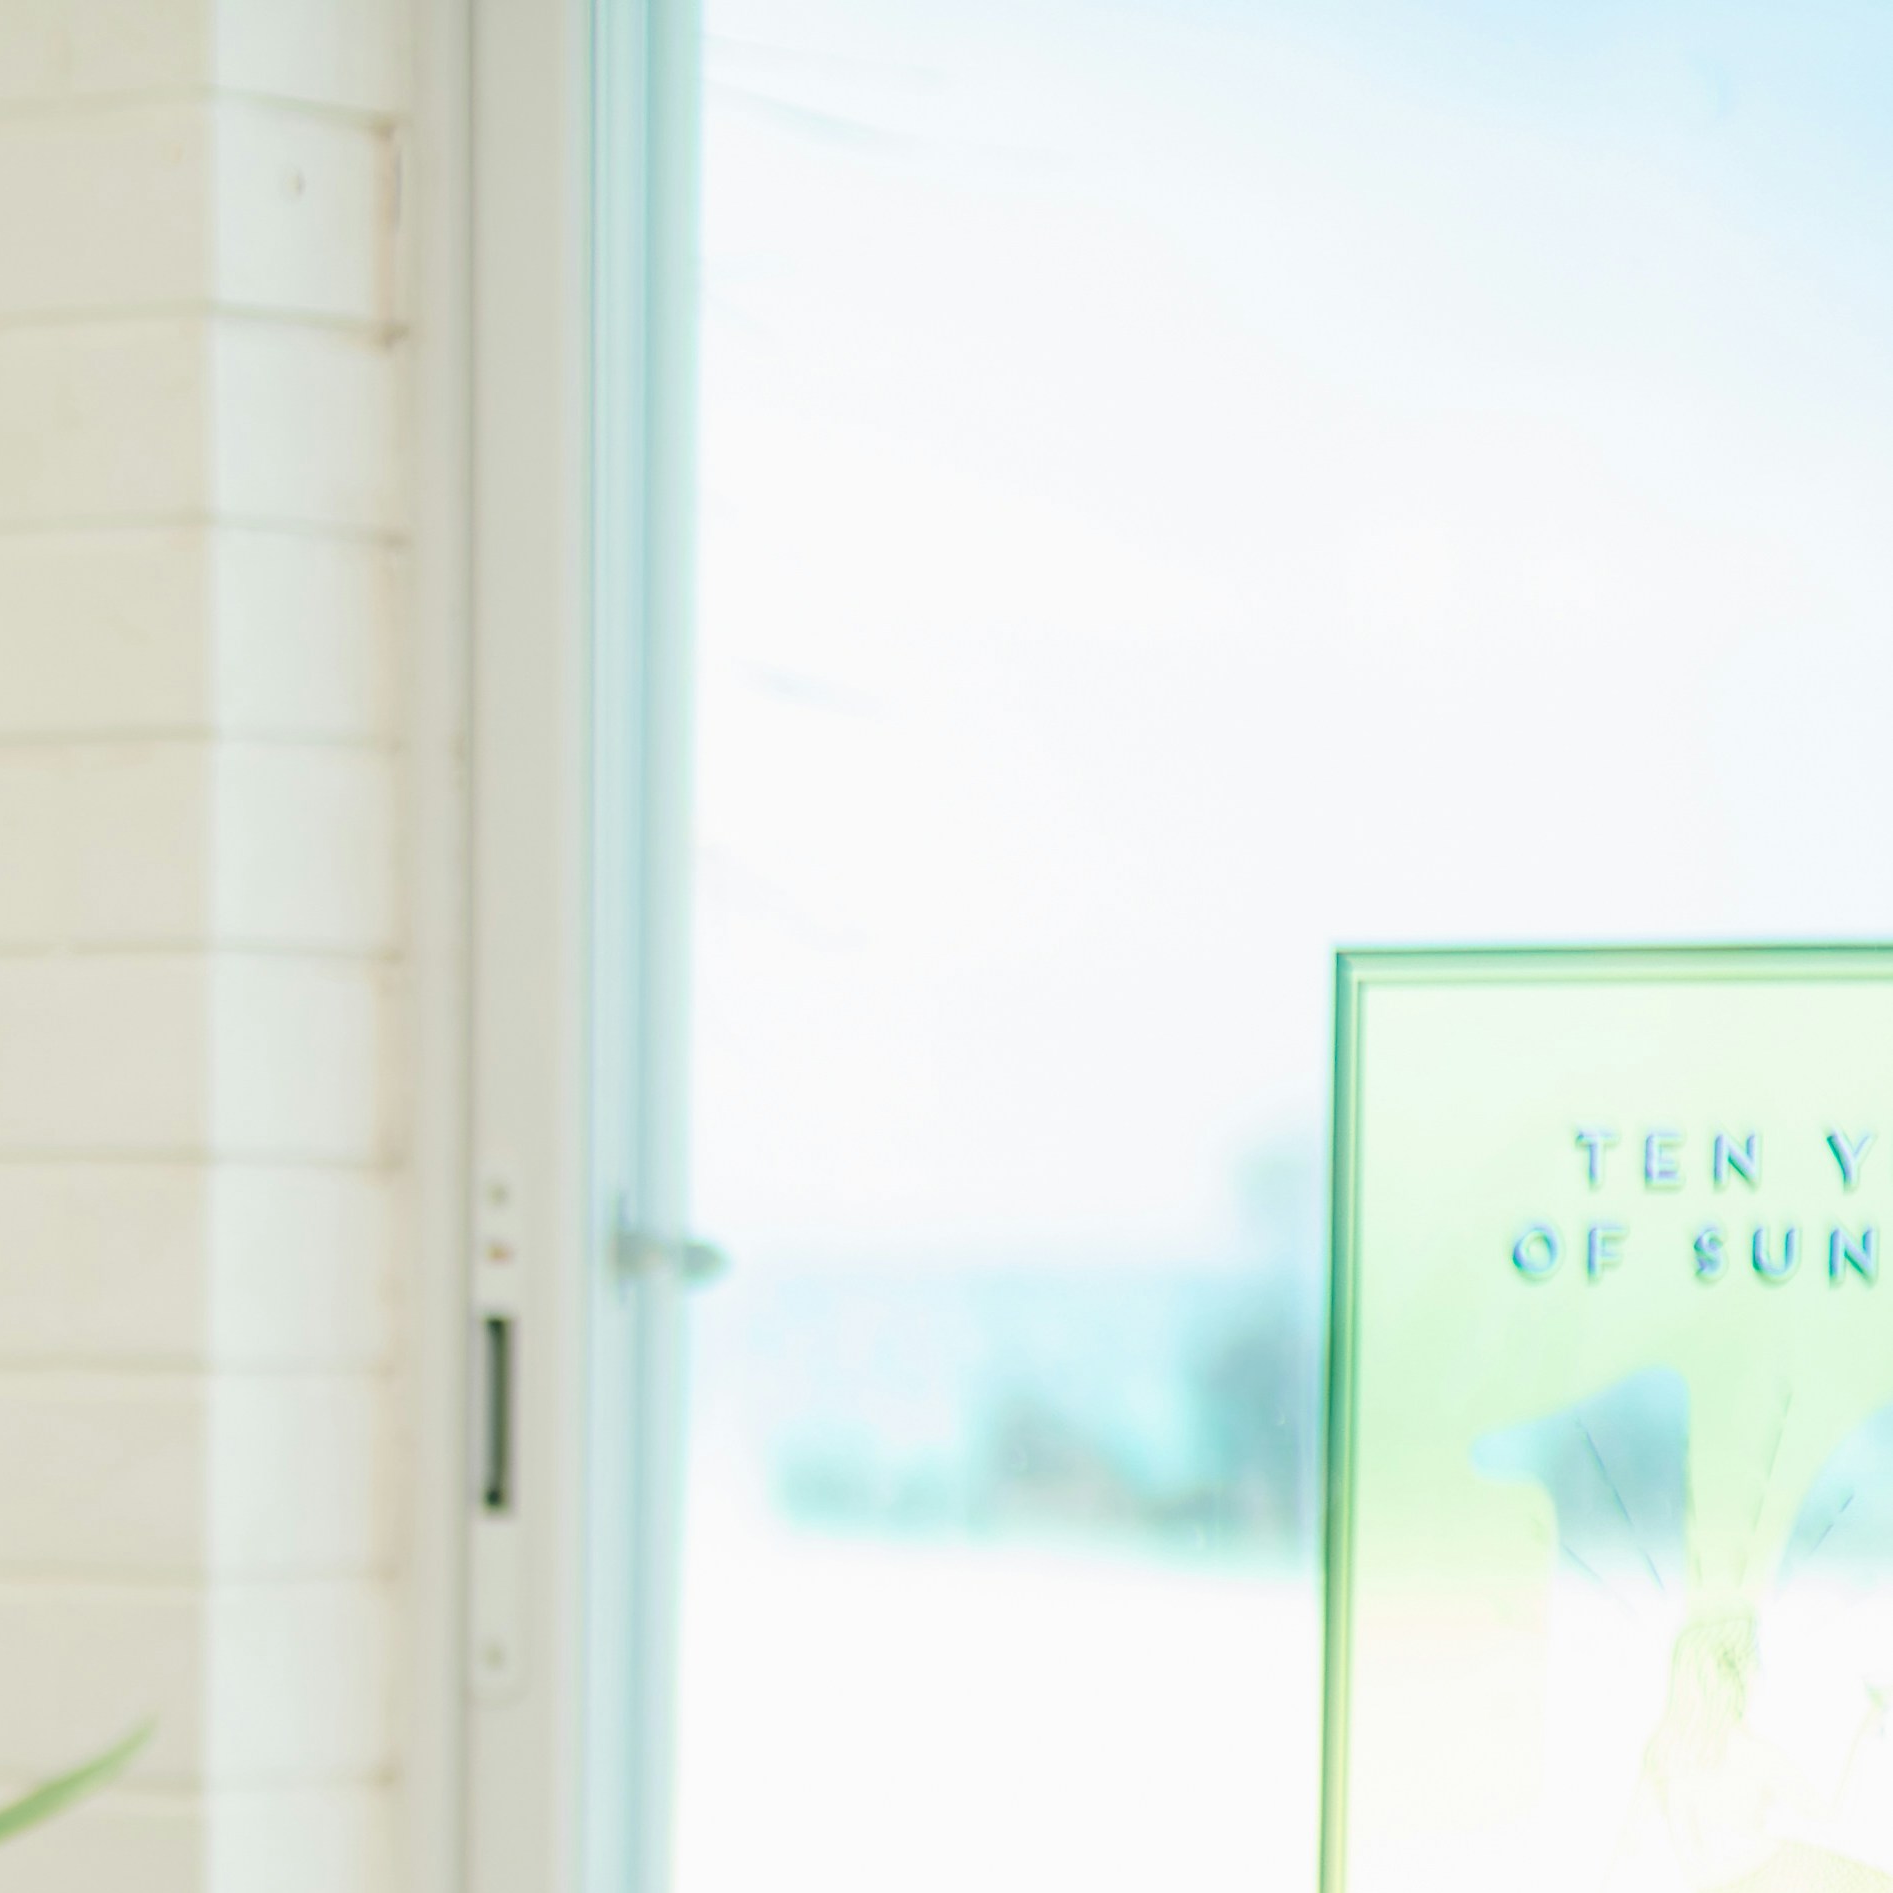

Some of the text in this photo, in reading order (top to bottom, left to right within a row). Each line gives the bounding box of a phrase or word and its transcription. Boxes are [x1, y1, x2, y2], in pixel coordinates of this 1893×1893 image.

[1575, 1128, 1761, 1192] TEN
[1511, 1220, 1879, 1287] OF SUN
